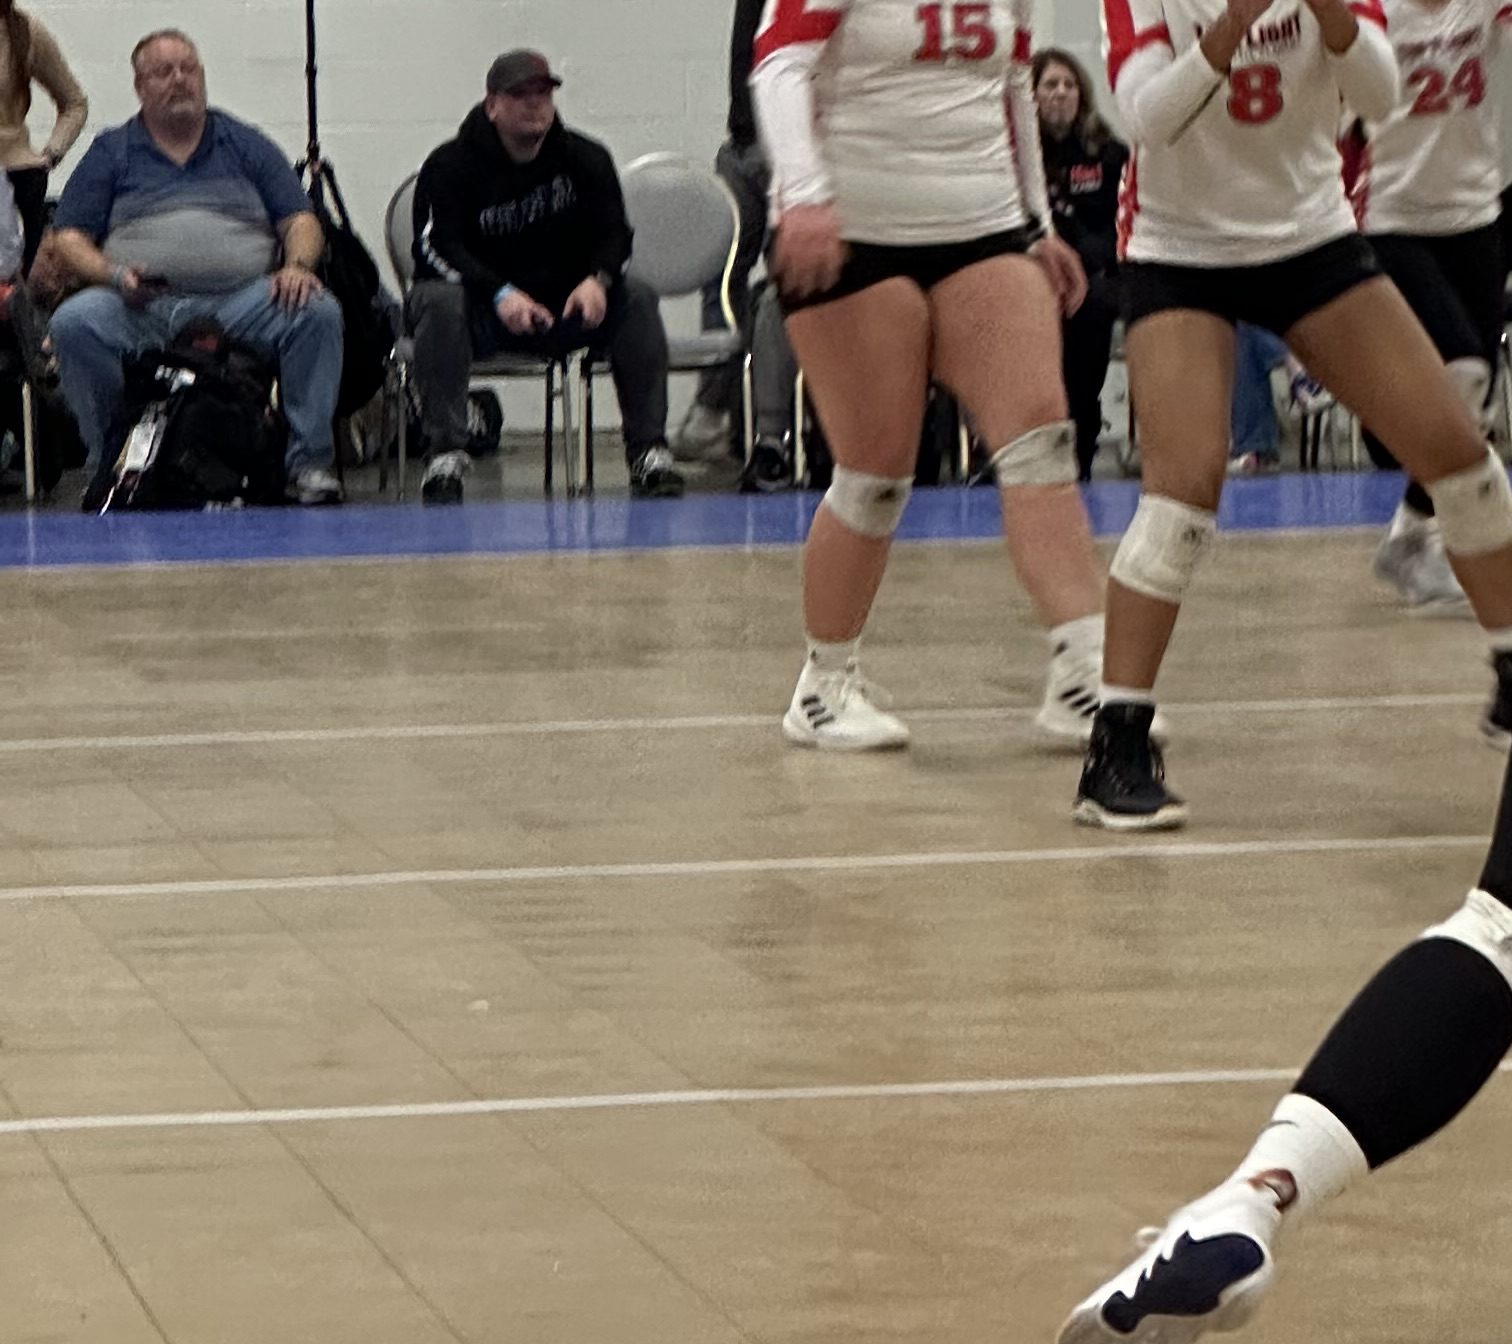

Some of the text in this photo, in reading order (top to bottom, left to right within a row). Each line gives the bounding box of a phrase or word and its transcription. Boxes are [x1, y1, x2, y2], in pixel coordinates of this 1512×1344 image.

[912, 3, 997, 62] 15
[1246, 11, 1301, 47] LIGHT
[1227, 63, 1283, 125] 8
[1407, 56, 1486, 117] 24
